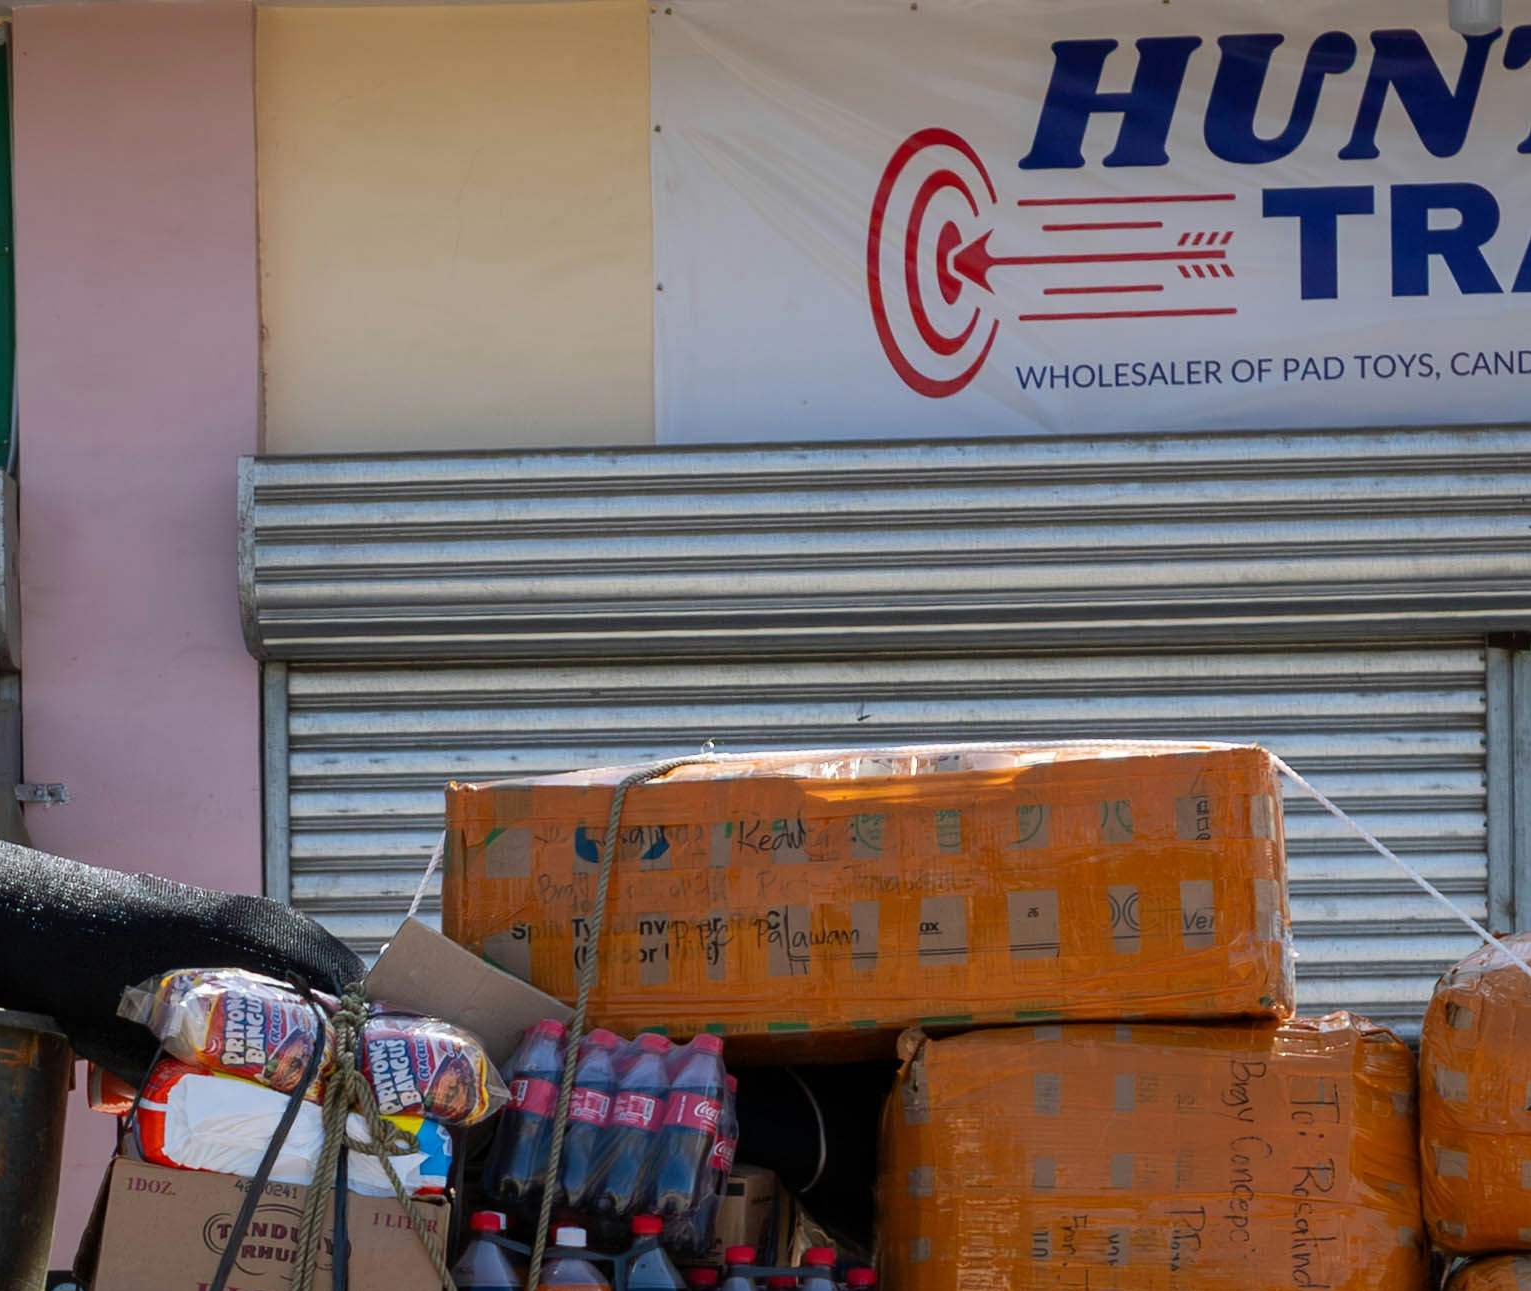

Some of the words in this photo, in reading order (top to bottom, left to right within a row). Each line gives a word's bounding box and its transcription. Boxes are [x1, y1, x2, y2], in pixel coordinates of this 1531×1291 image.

[1017, 360, 1222, 390] WHOLESALER
[1231, 358, 1273, 384] OF
[1283, 356, 1345, 381] PAD
[1353, 352, 1442, 380] TOYS,
[367, 1038, 404, 1116] PRITONG
[385, 1038, 423, 1107] BANGUS
[233, 1179, 299, 1200] 420241
